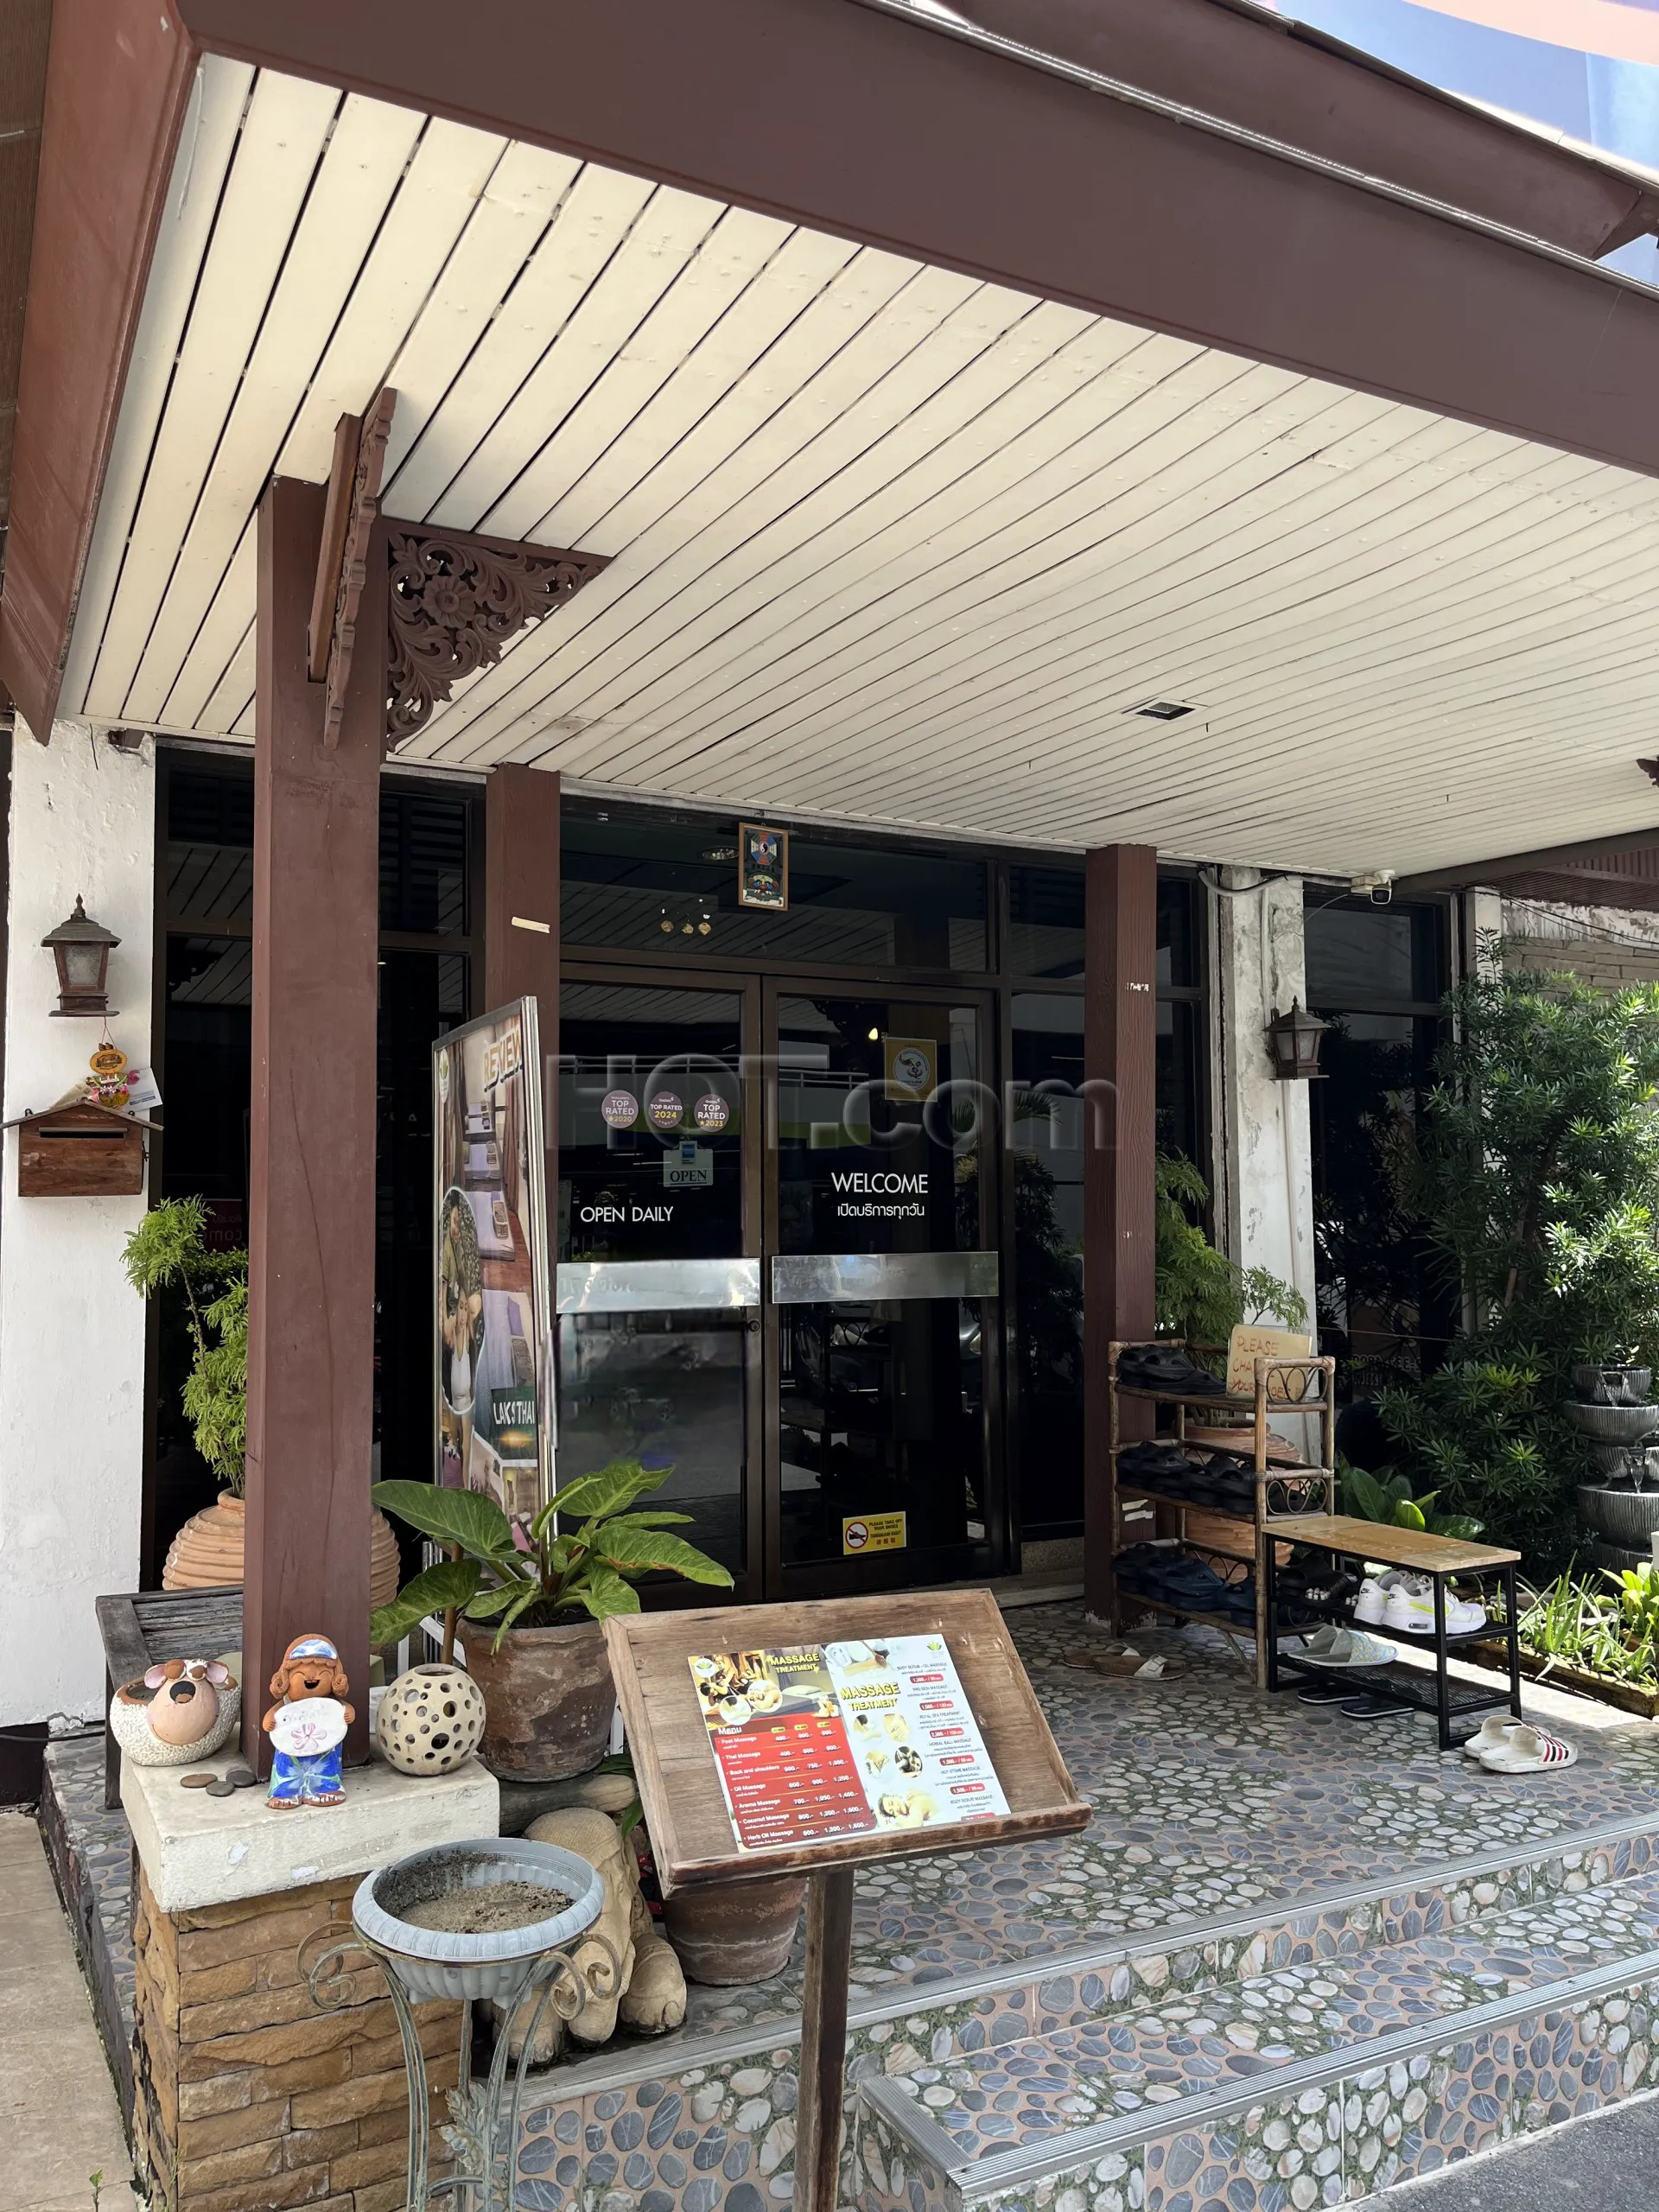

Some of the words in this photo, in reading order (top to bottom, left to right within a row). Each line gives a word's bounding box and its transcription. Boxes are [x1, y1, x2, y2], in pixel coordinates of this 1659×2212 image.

[606, 1107, 635, 1116] RATED
[654, 1110, 677, 1119] 2024
[702, 1103, 721, 1112] TOP
[697, 1111, 726, 1120] RATED
[670, 1169, 708, 1183] OPEN
[830, 1172, 929, 1194] WELCOME
[580, 1205, 626, 1223] OPEN
[632, 1205, 674, 1223] DAILY
[837, 1202, 925, 1220] เปิดบริการทุกวัน
[1236, 1335, 1279, 1357] PLEASE
[1231, 1377, 1255, 1393] YOUR
[771, 1653, 820, 1667] MASSAGE
[775, 1663, 817, 1674] TREATMENT
[840, 1681, 901, 1700] MASSAGE
[849, 1698, 899, 1712] TREATMENT
[718, 1726, 742, 1735] Menu
